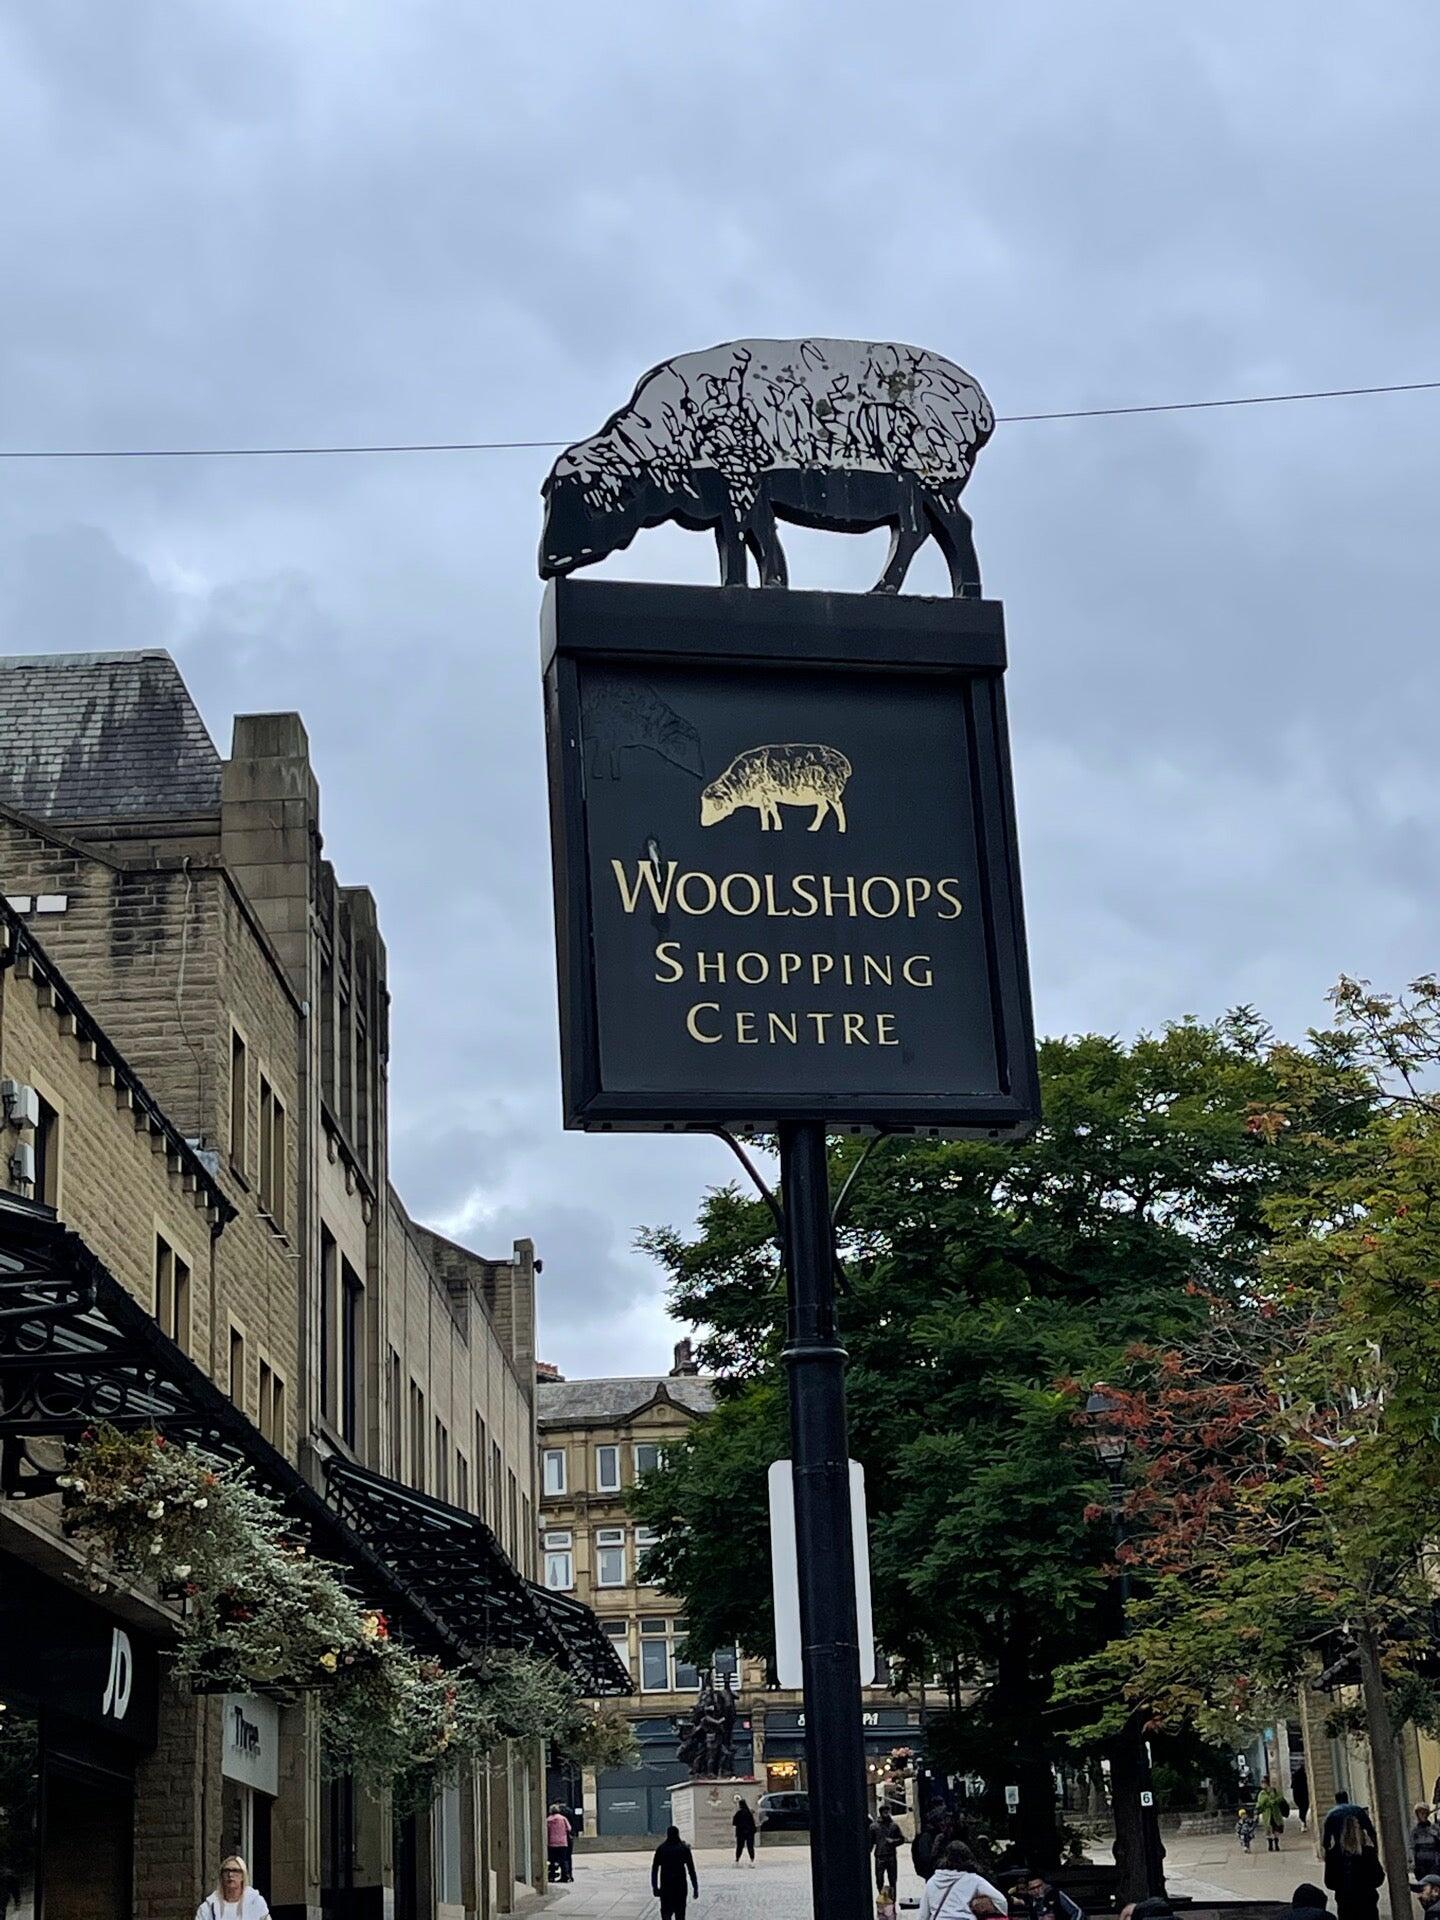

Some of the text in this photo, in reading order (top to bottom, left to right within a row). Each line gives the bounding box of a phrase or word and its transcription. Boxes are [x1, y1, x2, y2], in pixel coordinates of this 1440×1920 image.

[611, 858, 964, 921] WOOLSHOPS
[654, 941, 934, 988] SHOPPING
[686, 1002, 900, 1046] CENTRE
[102, 1627, 132, 1720] JD
[1143, 1793, 1150, 1803] 6
